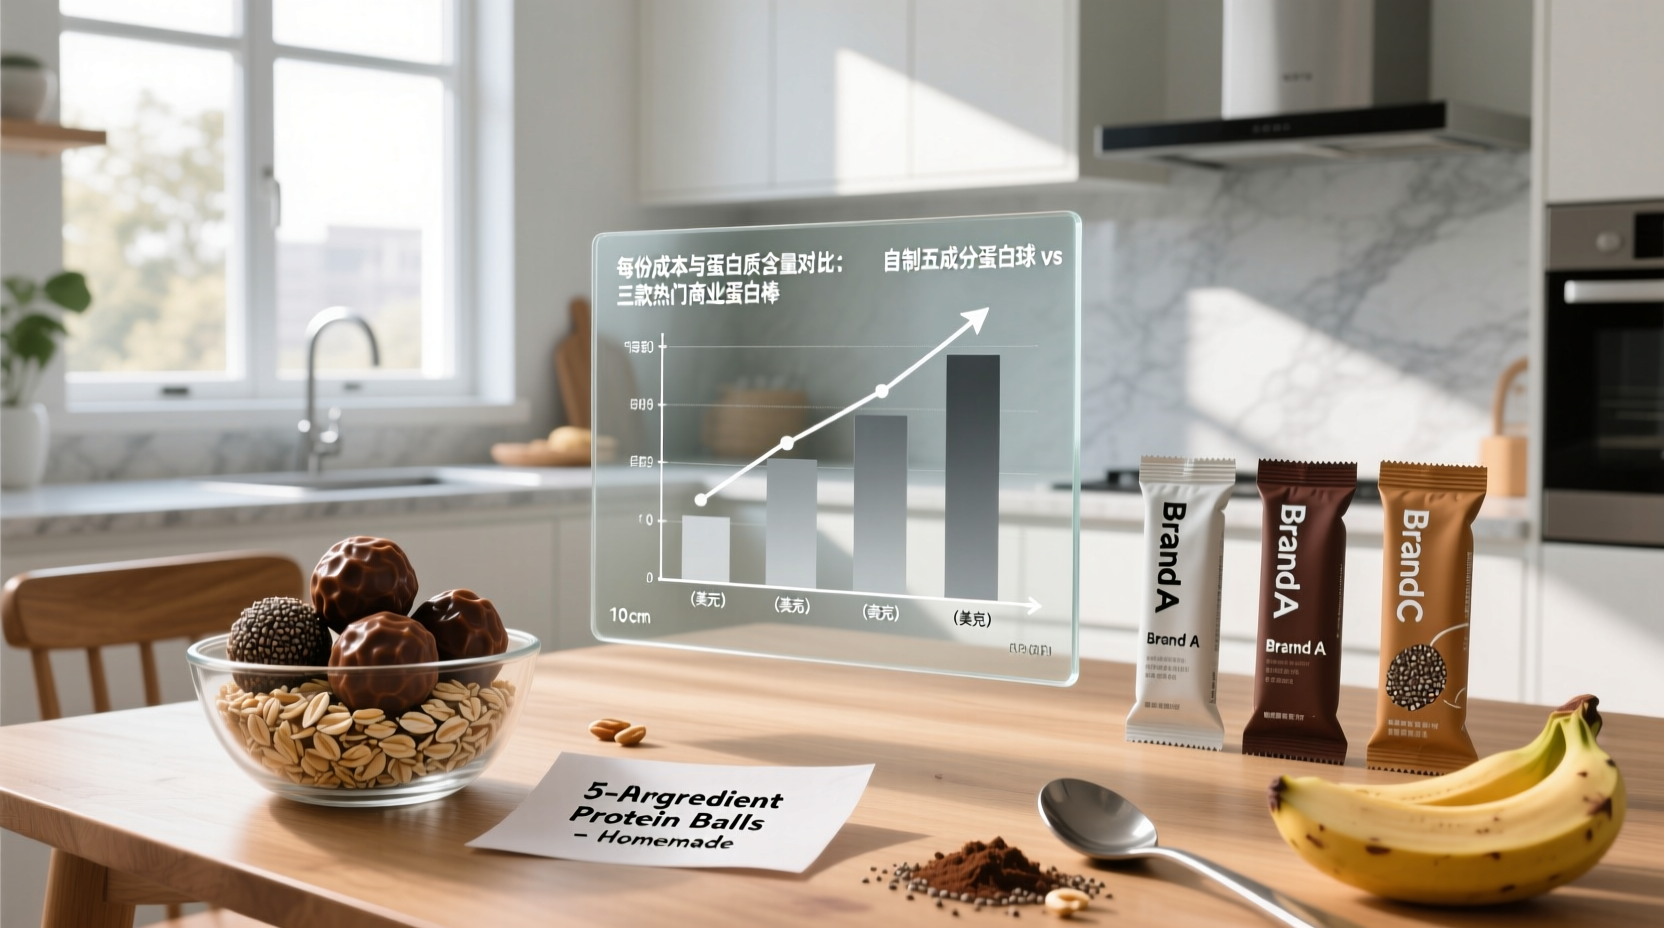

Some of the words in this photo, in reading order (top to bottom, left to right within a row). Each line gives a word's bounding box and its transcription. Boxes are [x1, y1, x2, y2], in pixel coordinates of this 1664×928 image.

[884, 245, 1036, 273] 自制五成分蛋白球
[617, 280, 781, 307] 三款热门商业蛋白棒
[1189, 634, 1200, 648] A
[1314, 641, 1327, 656] A
[569, 805, 680, 828] Protein
[689, 812, 765, 831] Balls
[597, 830, 734, 850] Homemade
